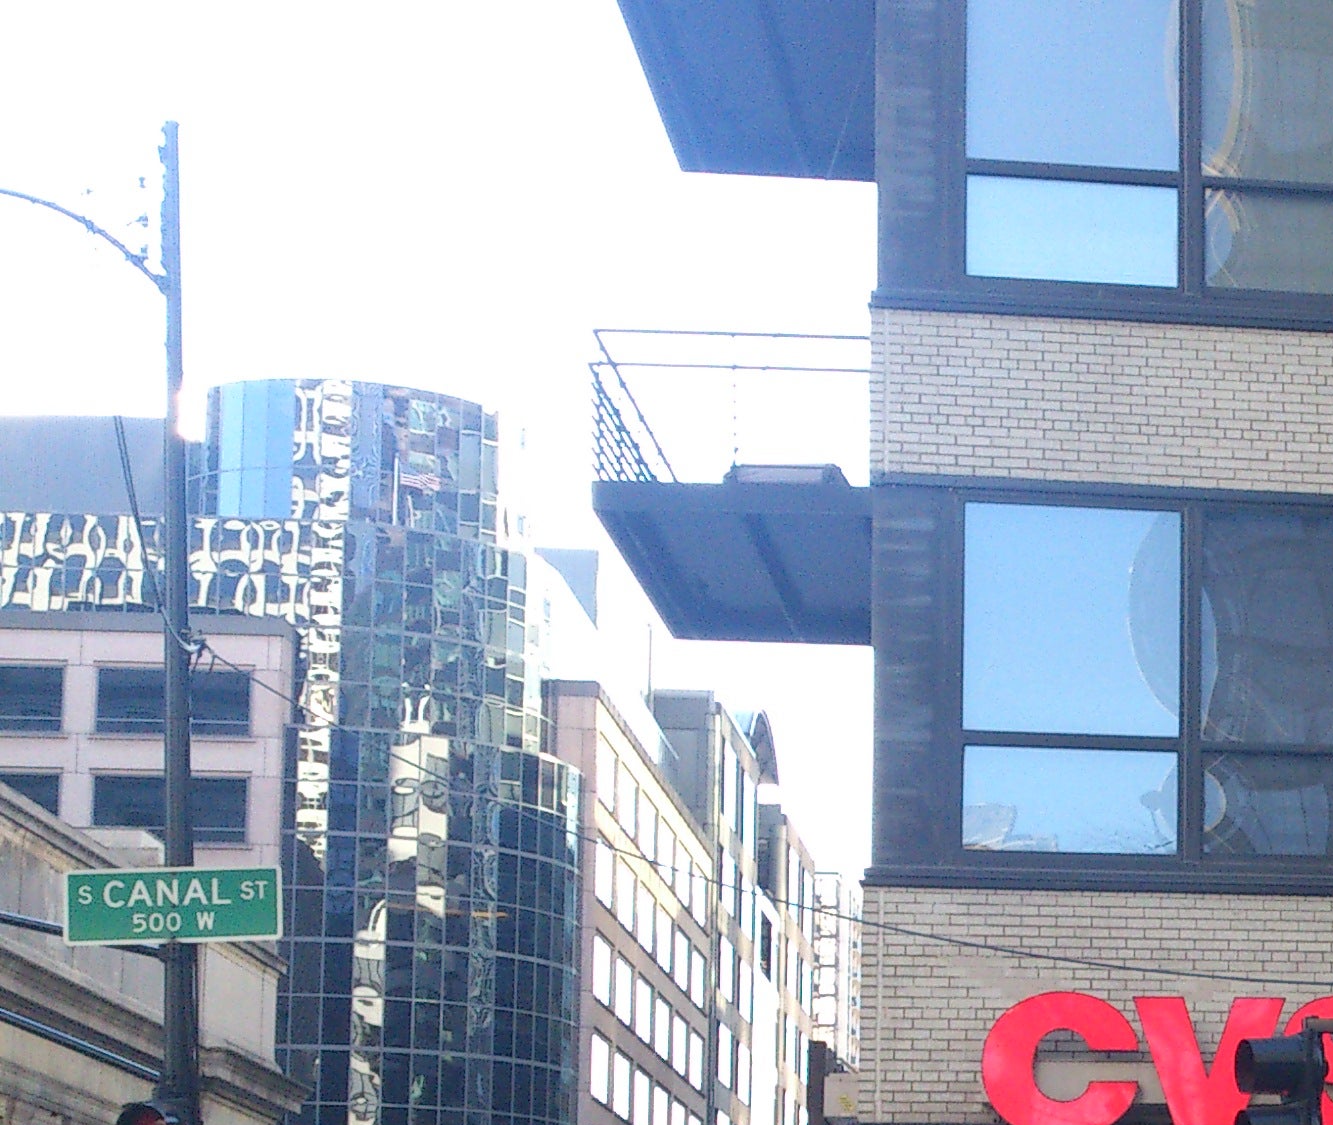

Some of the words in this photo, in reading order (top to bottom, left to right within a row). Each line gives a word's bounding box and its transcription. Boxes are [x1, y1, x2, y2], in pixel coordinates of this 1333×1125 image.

[78, 886, 93, 905] S
[103, 878, 232, 908] CANAL
[240, 881, 268, 900] ST
[132, 912, 182, 933] 500
[196, 911, 215, 931] W
